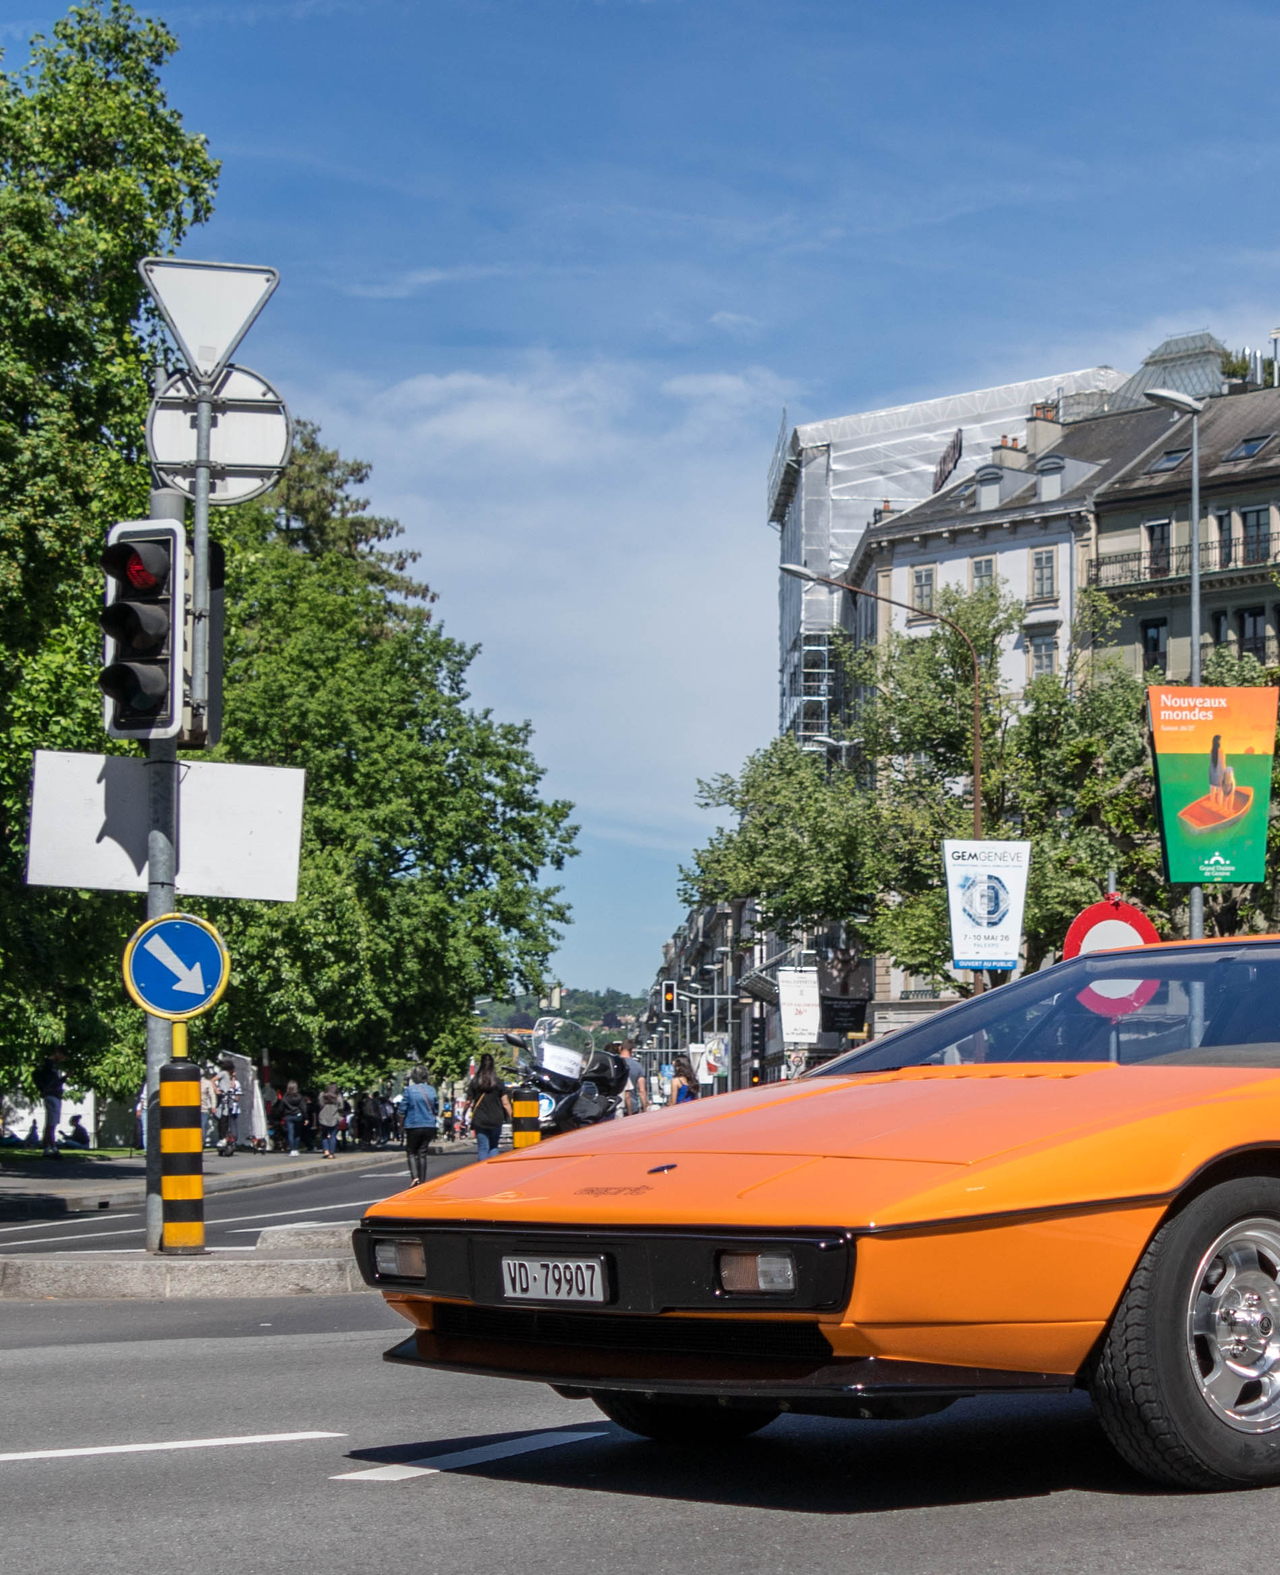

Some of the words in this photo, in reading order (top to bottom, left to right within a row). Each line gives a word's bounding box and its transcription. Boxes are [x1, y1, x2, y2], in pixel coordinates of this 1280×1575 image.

[1160, 694, 1228, 708] Nouveaux
[1160, 708, 1213, 721] mondes
[507, 1261, 529, 1294] VD
[540, 1263, 596, 1297] 79907
